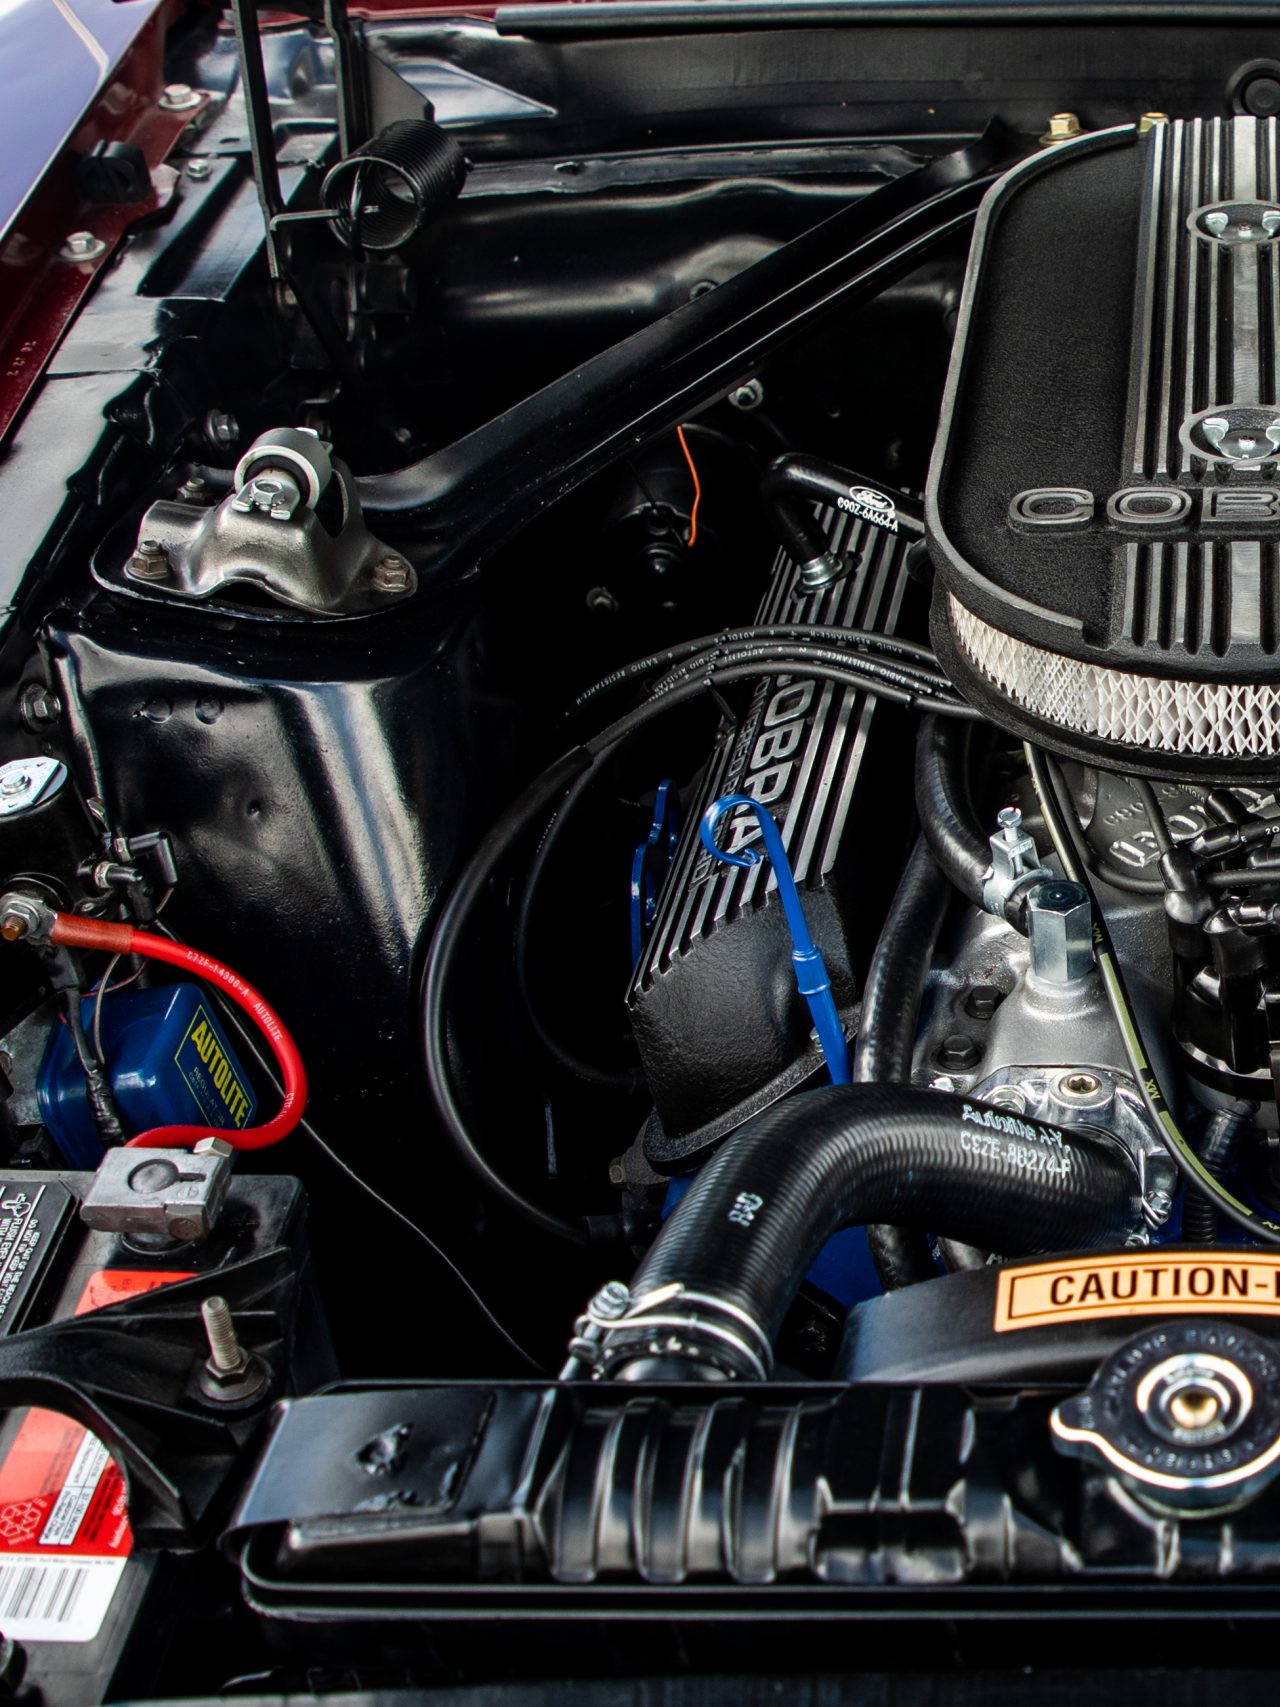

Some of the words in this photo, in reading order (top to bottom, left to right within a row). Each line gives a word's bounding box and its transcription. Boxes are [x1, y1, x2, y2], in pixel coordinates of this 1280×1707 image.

[717, 674, 817, 867] OBRA
[253, 1001, 284, 1043] AUTOLITE
[191, 1019, 250, 1128] AUTOLITE
[5, 1218, 23, 1241] FLUSH
